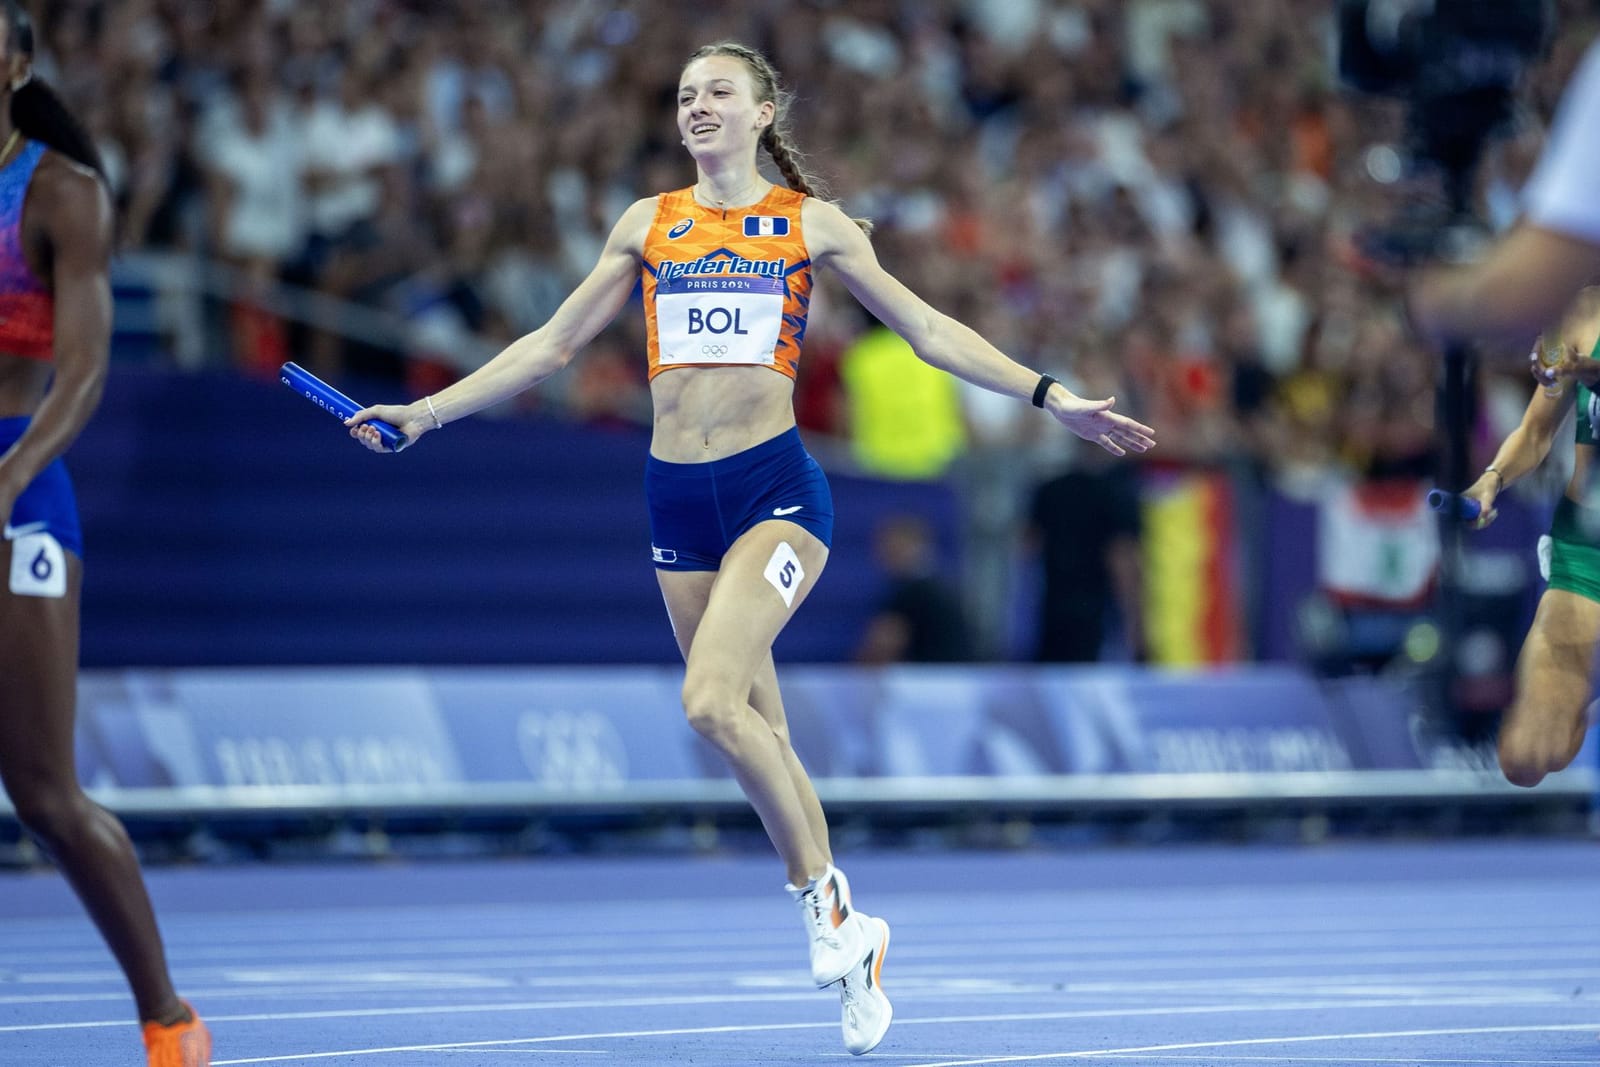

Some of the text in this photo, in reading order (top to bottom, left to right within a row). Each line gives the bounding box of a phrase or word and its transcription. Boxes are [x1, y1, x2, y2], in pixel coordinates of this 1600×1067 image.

[687, 281, 750, 289] PARIS 2024
[688, 307, 748, 335] BOL
[31, 547, 52, 581] 6
[779, 560, 796, 589] 5
